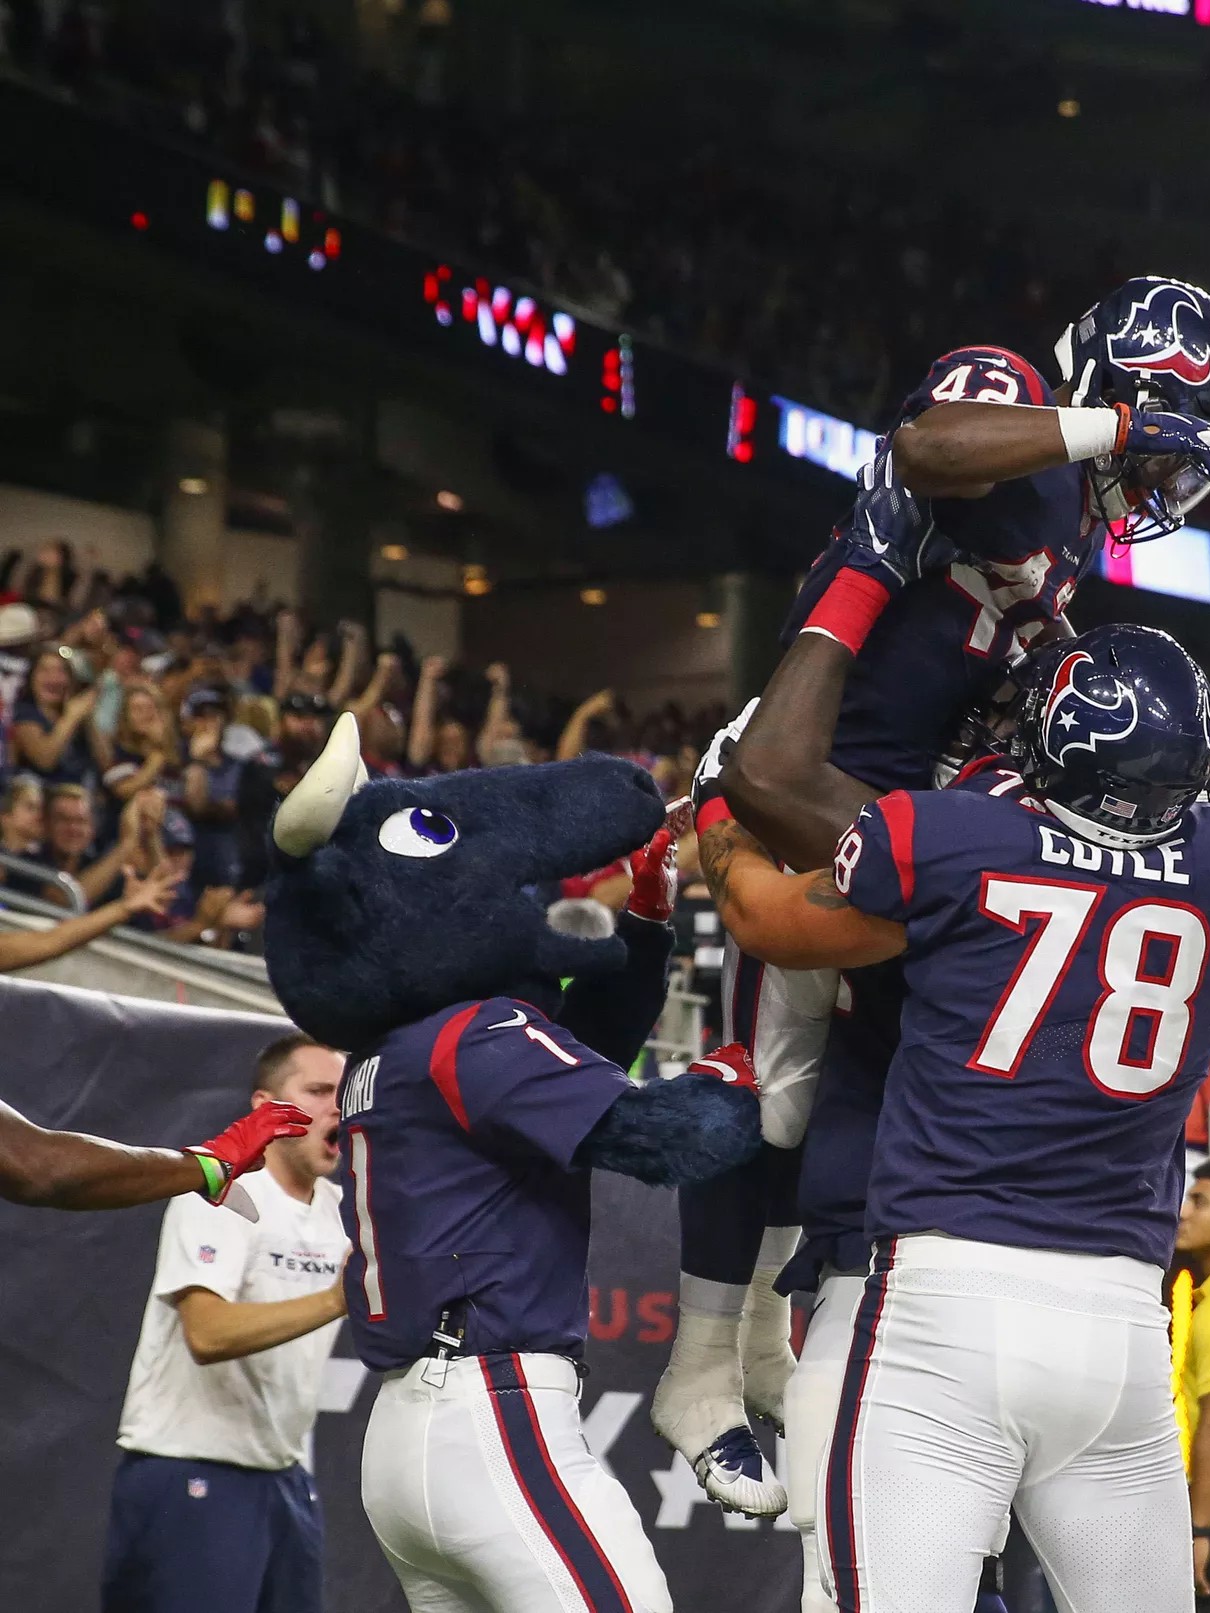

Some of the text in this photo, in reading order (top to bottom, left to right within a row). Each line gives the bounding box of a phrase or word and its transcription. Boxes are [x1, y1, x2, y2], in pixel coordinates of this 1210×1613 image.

[931, 363, 1021, 402] 42
[522, 1024, 580, 1067] 1
[965, 872, 1210, 1101] 78
[350, 1124, 387, 1323] 1
